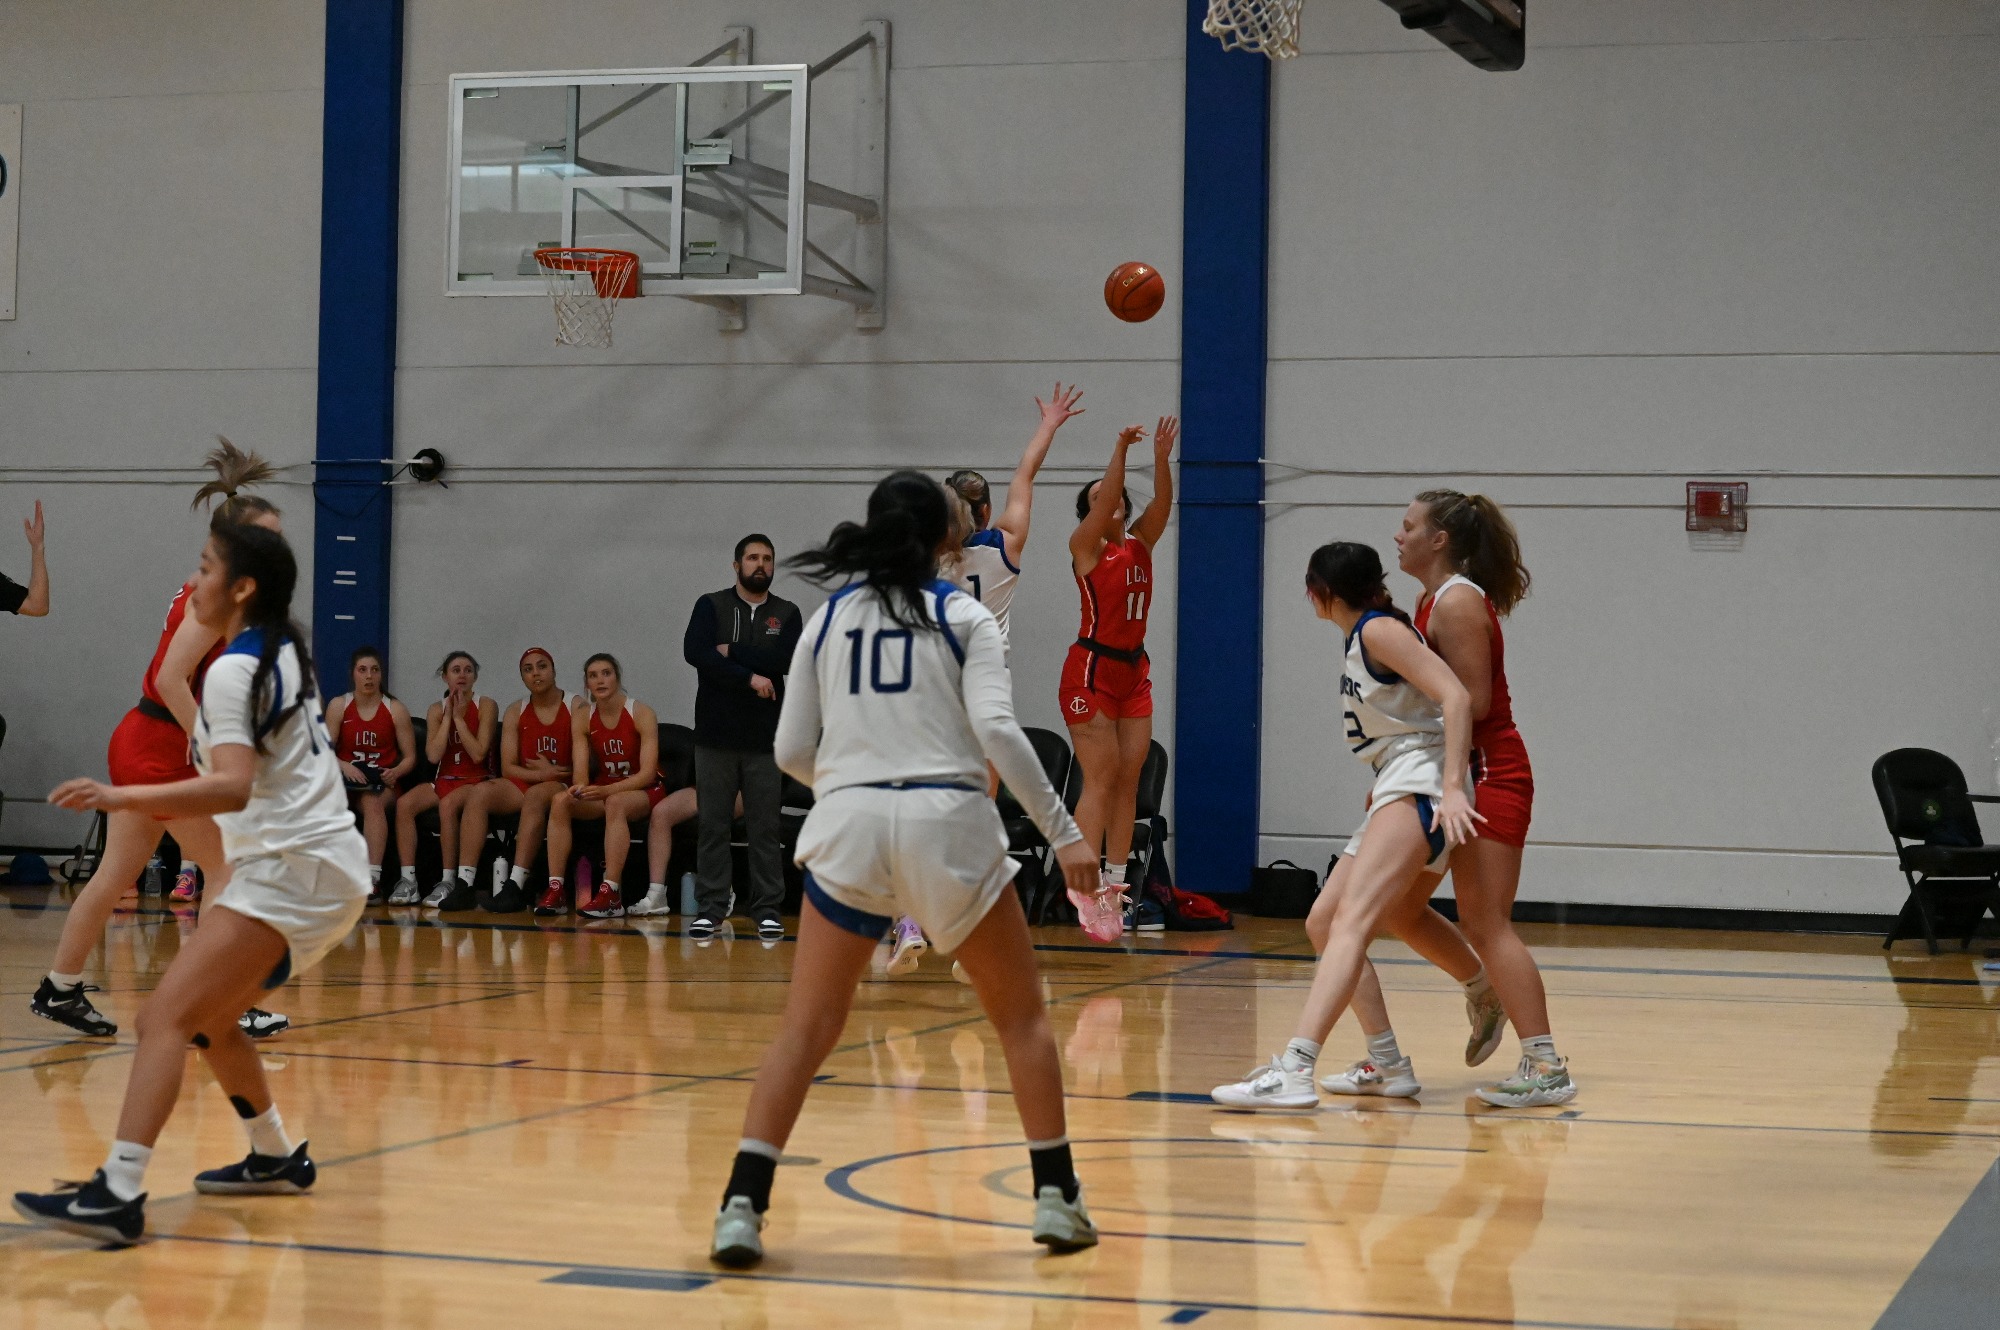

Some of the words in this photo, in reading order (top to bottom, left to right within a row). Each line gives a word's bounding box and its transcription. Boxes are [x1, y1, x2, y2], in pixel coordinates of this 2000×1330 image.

[1126, 591, 1145, 621] 11
[845, 628, 914, 694] 10
[355, 730, 377, 747] LCC
[537, 735, 557, 754] LCC
[603, 738, 625, 756] LCC
